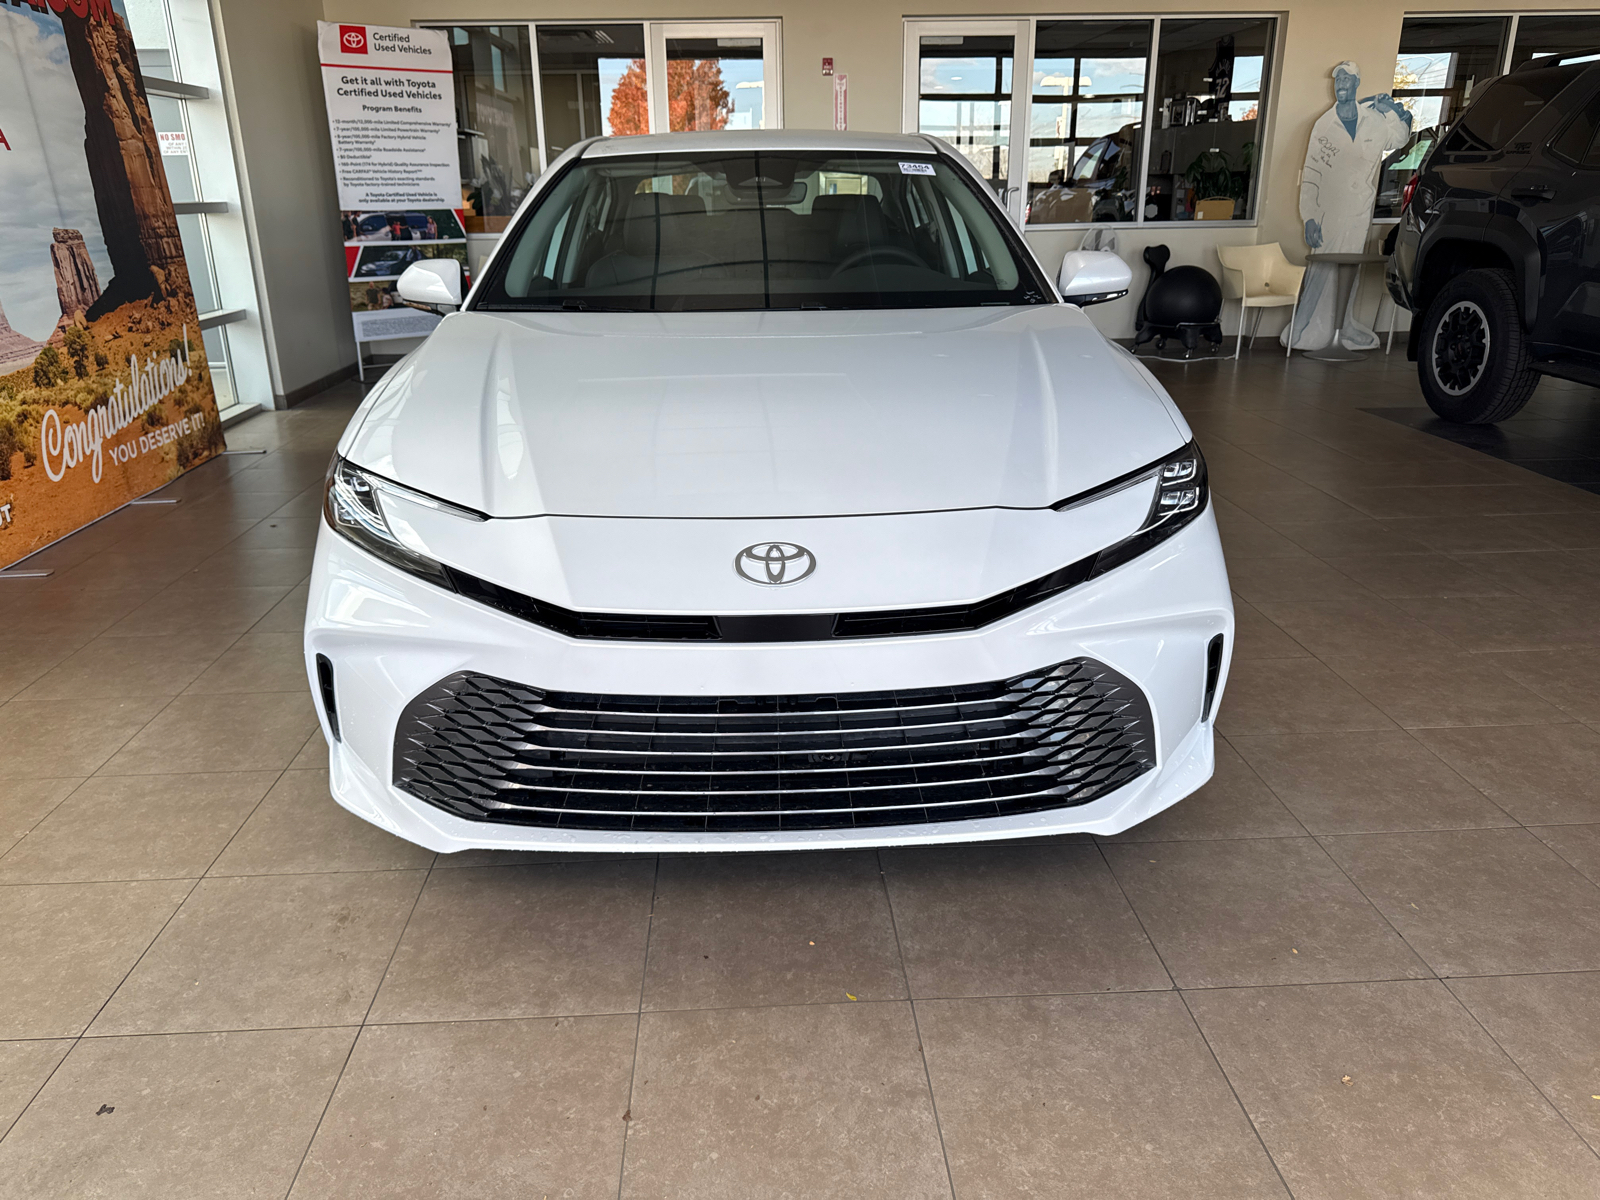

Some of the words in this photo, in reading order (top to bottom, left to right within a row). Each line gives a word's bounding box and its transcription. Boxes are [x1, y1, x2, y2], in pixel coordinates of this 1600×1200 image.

[373, 32, 410, 43] Certified
[374, 43, 396, 53] Used
[397, 44, 432, 55] Vehicles
[341, 76, 359, 85] Get
[361, 77, 368, 85] it
[370, 77, 383, 86] all
[384, 78, 405, 88] with
[406, 79, 436, 89] Toyota
[337, 87, 379, 98] Certified
[380, 89, 404, 99] Used
[405, 89, 442, 100] Vehicles
[362, 105, 393, 113] Program
[41, 323, 192, 482] Congratulations!
[109, 438, 138, 466] YOU
[140, 419, 190, 455] DESERVE
[191, 411, 205, 432] IT!
